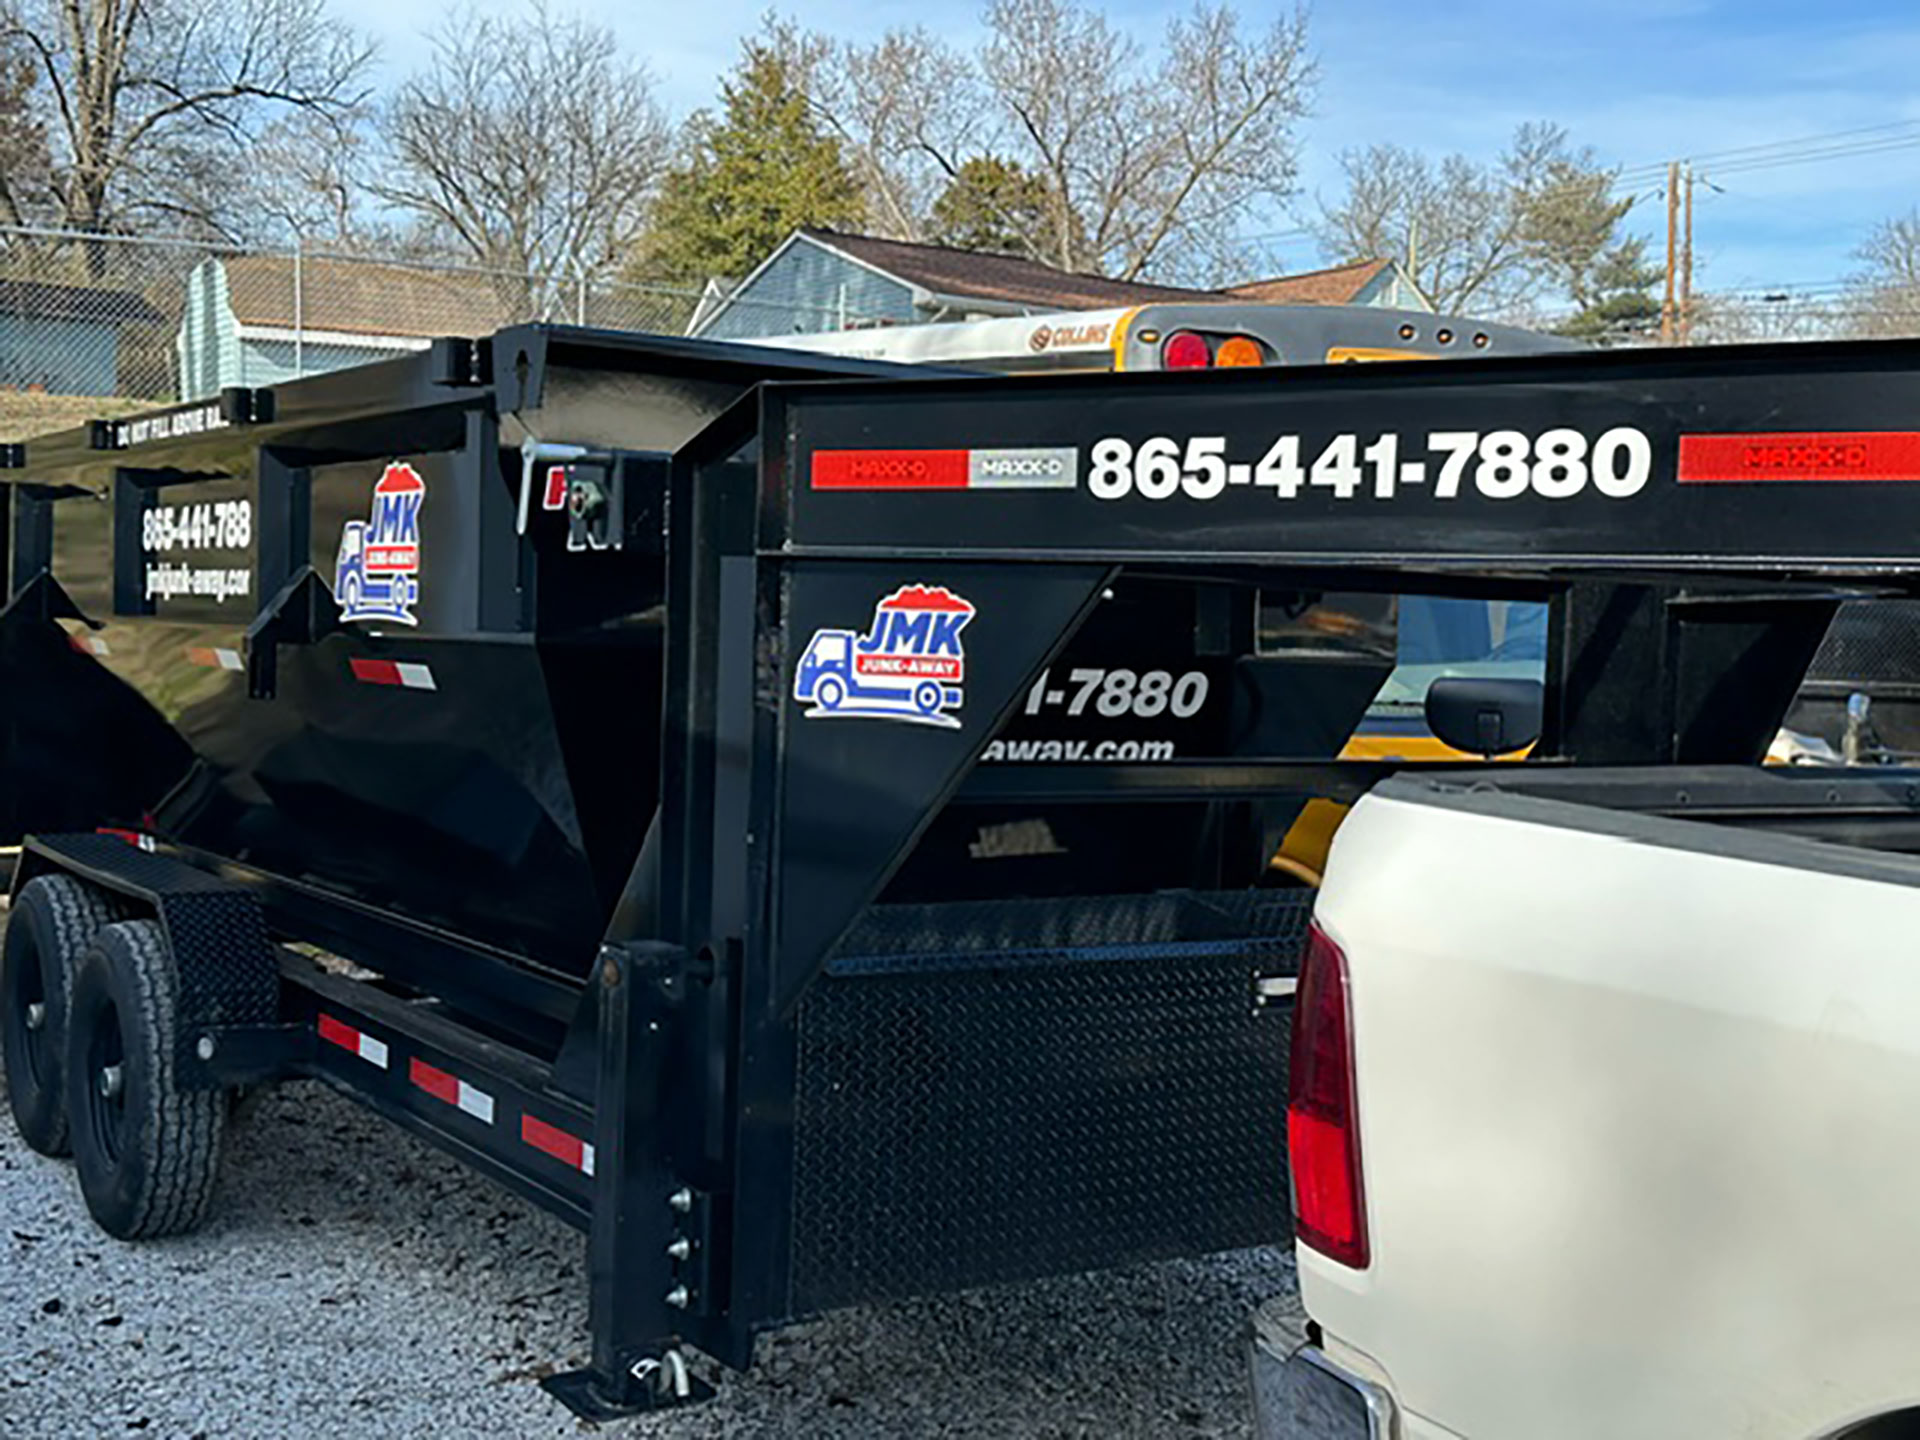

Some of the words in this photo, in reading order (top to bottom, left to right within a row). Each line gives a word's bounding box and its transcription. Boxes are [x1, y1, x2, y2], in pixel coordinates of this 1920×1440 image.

[1087, 427, 1652, 499] 865-441-7880
[143, 500, 251, 551] 865-441-788
[365, 493, 421, 543] JMK
[857, 611, 969, 654] JMK
[861, 659, 955, 674] JUNK-AWAY
